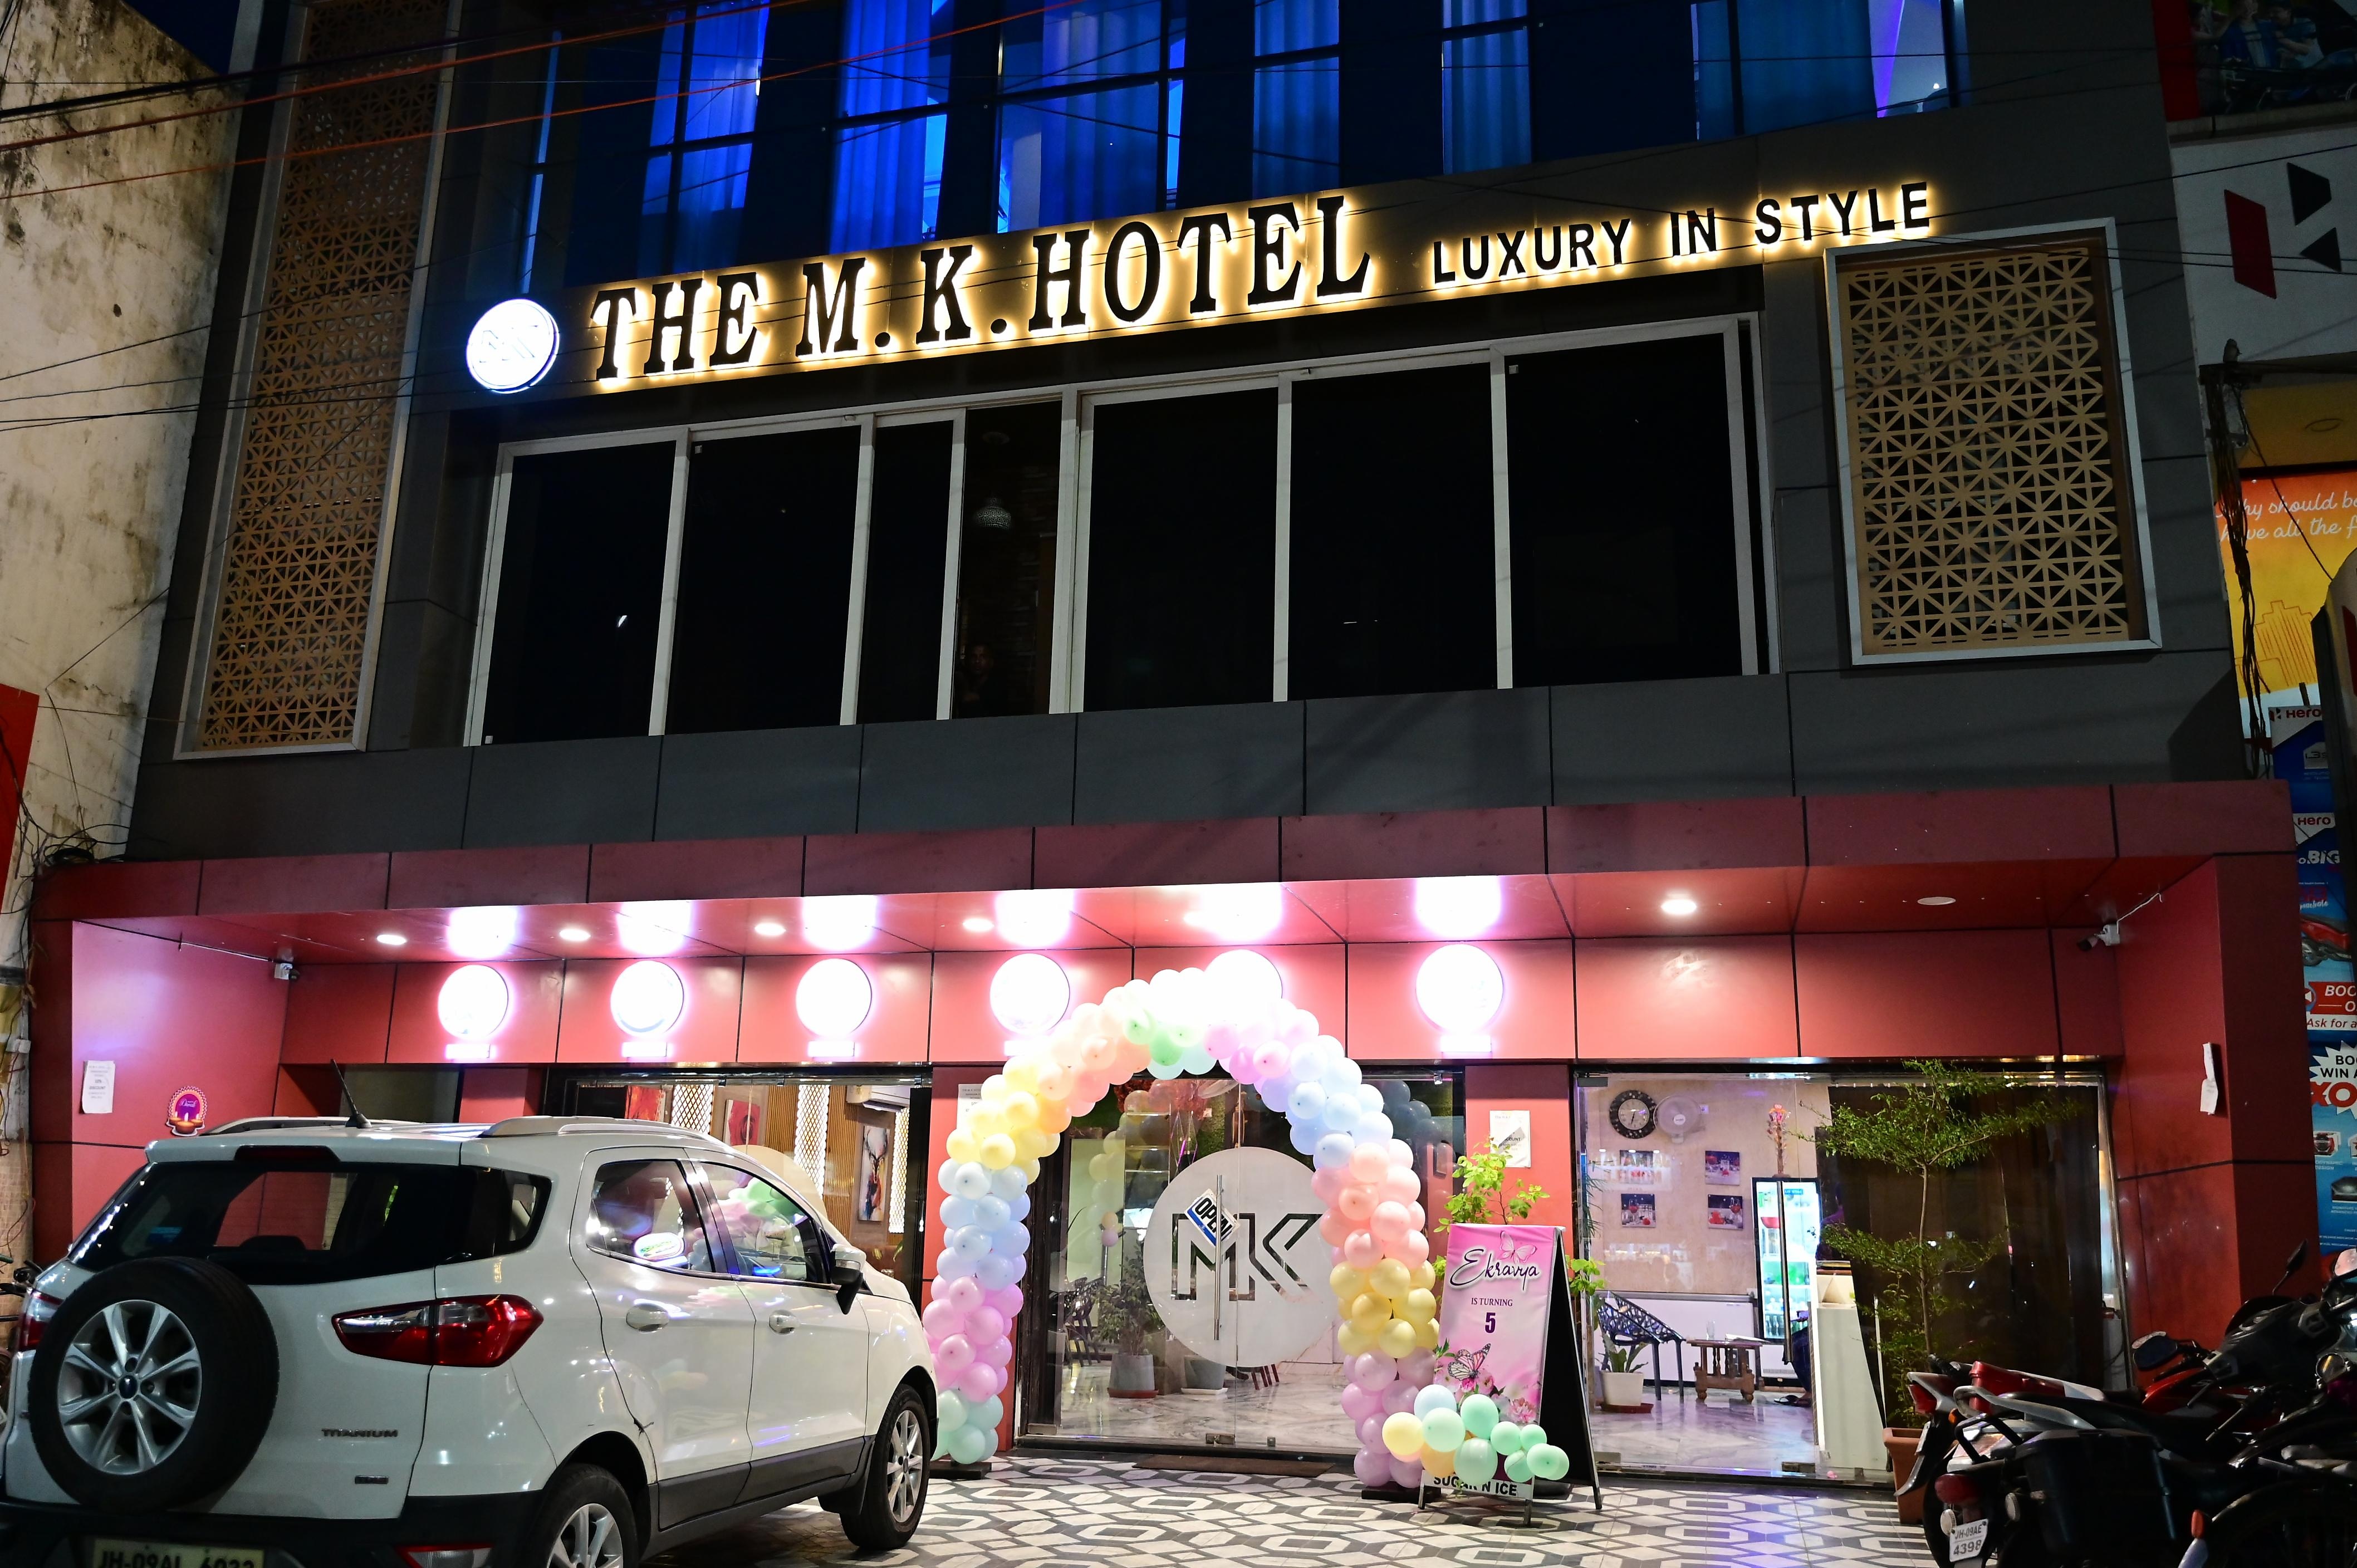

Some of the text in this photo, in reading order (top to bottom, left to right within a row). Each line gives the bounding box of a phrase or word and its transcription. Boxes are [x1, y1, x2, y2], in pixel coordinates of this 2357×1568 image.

[1433, 182, 1930, 285] LUXURY IN STYLE
[591, 271, 756, 381] THE
[1030, 195, 1371, 331] HOTEL
[2268, 492, 2338, 513] should
[2274, 519, 2302, 538] all
[2310, 518, 2341, 536] the
[2297, 817, 2331, 825] Hero
[2307, 1018, 2327, 1027] Ask
[2331, 1018, 2348, 1028] for
[2336, 1055, 2357, 1065] BO
[2320, 1067, 2349, 1078] WIN
[1194, 1197, 1233, 1238] OPEN
[1172, 1213, 1324, 1302] MK
[1479, 1298, 1513, 1307] TURNING
[1484, 1312, 1496, 1334] 5
[321, 1428, 399, 1438] TITANIUM
[1482, 1481, 1491, 1492] N
[1495, 1482, 1517, 1496] ICE
[1954, 1525, 1982, 1540] JH-09AE
[1953, 1539, 1982, 1555] 4398
